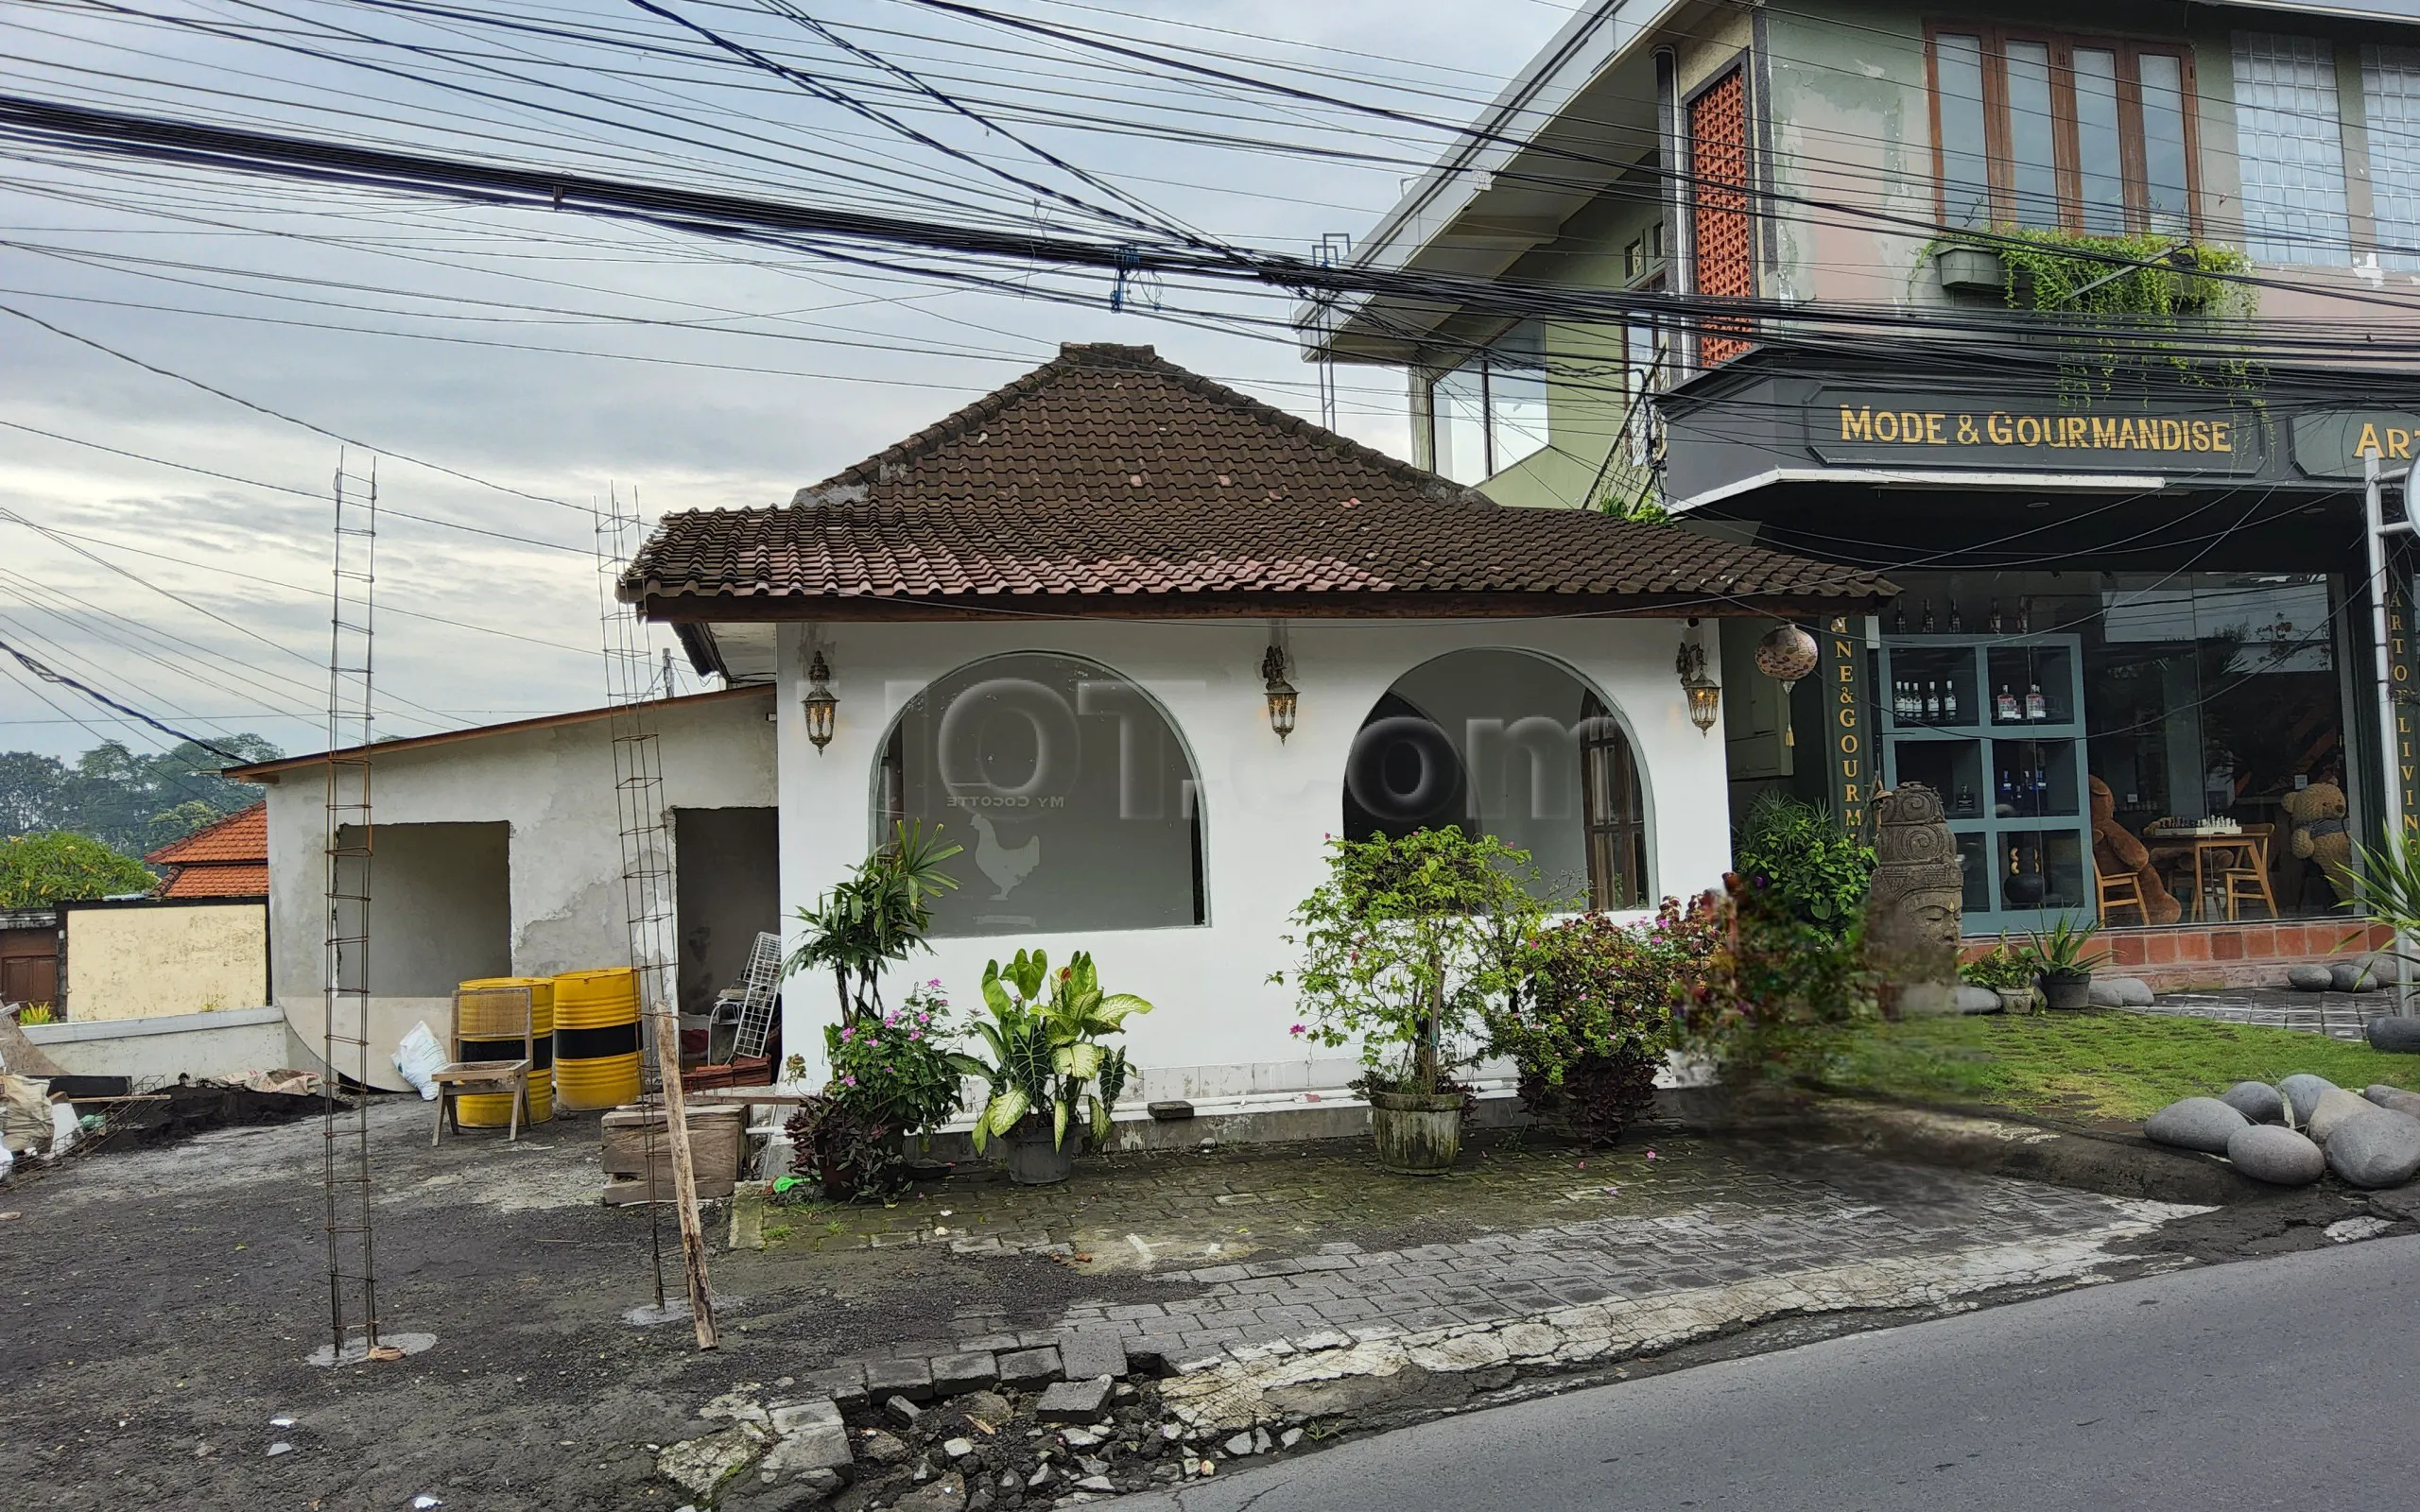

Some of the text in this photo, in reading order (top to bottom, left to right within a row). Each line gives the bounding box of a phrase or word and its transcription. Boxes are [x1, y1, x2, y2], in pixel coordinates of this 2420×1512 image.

[1840, 404, 2232, 453] MODE & GOURMANDISE
[2352, 422, 2420, 460] AR
